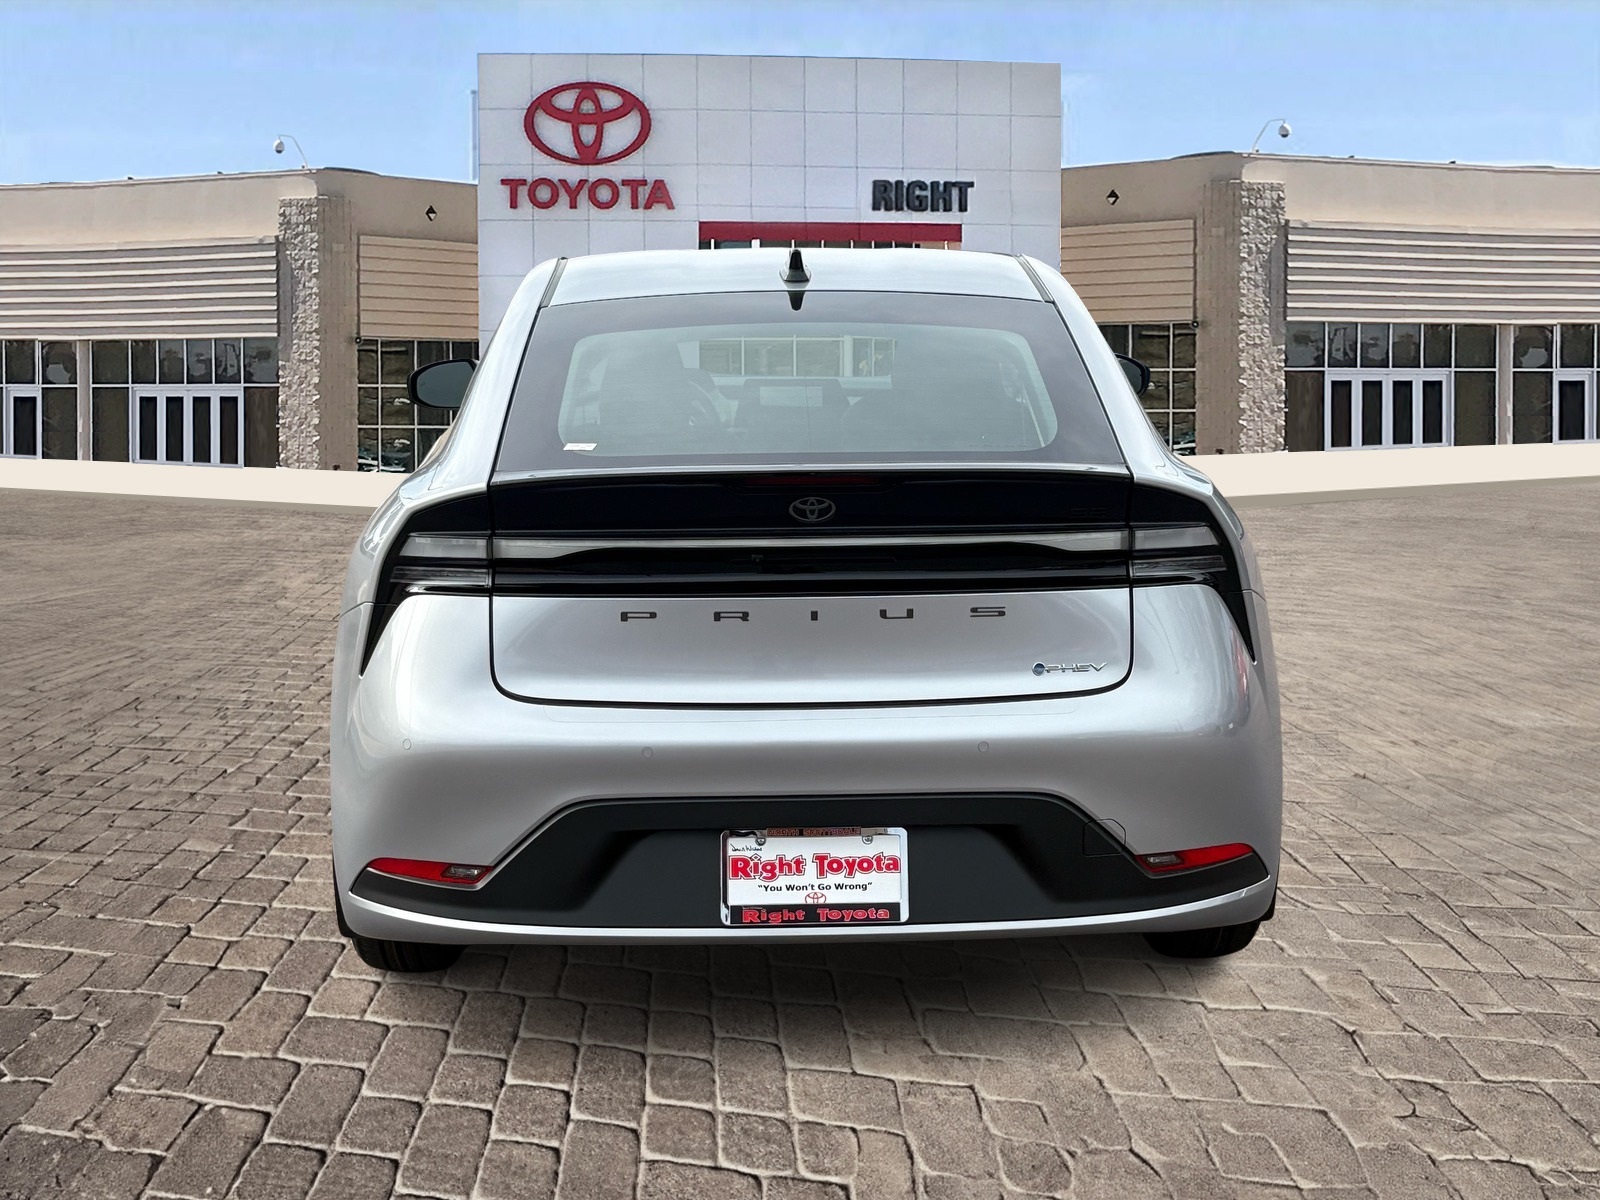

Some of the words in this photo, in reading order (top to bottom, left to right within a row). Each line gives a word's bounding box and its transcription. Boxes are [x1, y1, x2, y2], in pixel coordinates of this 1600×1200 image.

[500, 178, 675, 210] TOYOTA
[872, 180, 975, 213] RIGHT
[620, 606, 1007, 623] PRIUS
[729, 853, 806, 882] Right
[812, 852, 901, 879] Toyota
[818, 882, 832, 891] Go
[742, 909, 805, 924] Right
[817, 907, 890, 921] Toyota
